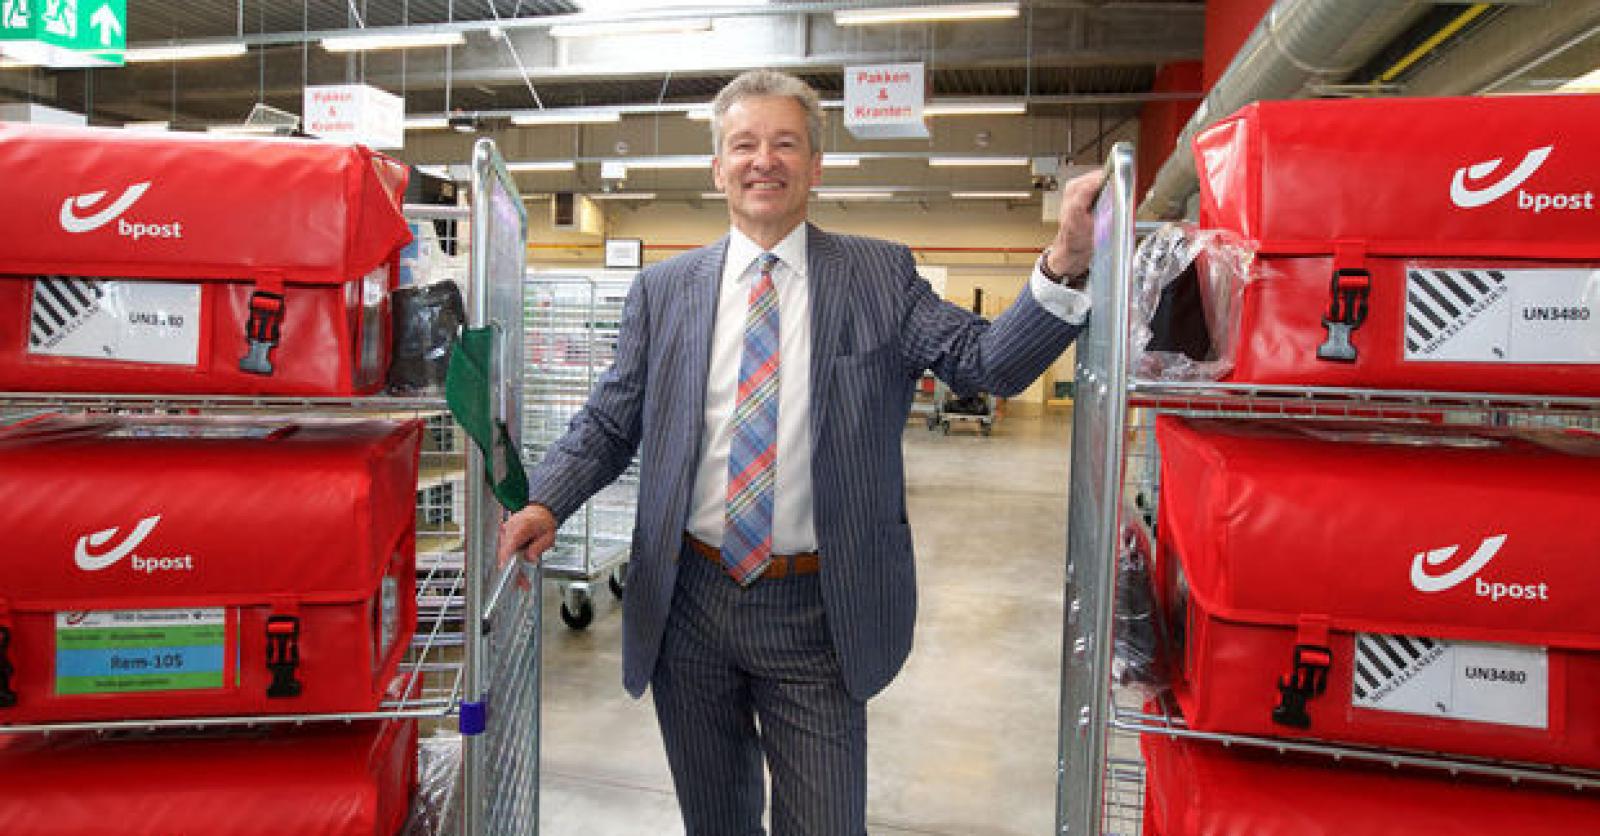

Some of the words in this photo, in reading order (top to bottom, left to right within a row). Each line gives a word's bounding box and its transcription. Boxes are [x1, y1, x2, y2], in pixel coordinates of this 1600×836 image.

[857, 70, 911, 84] Pakken
[877, 88, 888, 101] &
[855, 106, 912, 118] Kranten
[1518, 189, 1593, 214] bpost
[118, 218, 182, 241] bpost
[128, 311, 184, 327] UN380
[1522, 306, 1591, 321] UN3480
[131, 554, 194, 574] bpost
[1475, 577, 1549, 602] bpost
[1465, 666, 1527, 684] UN3480
